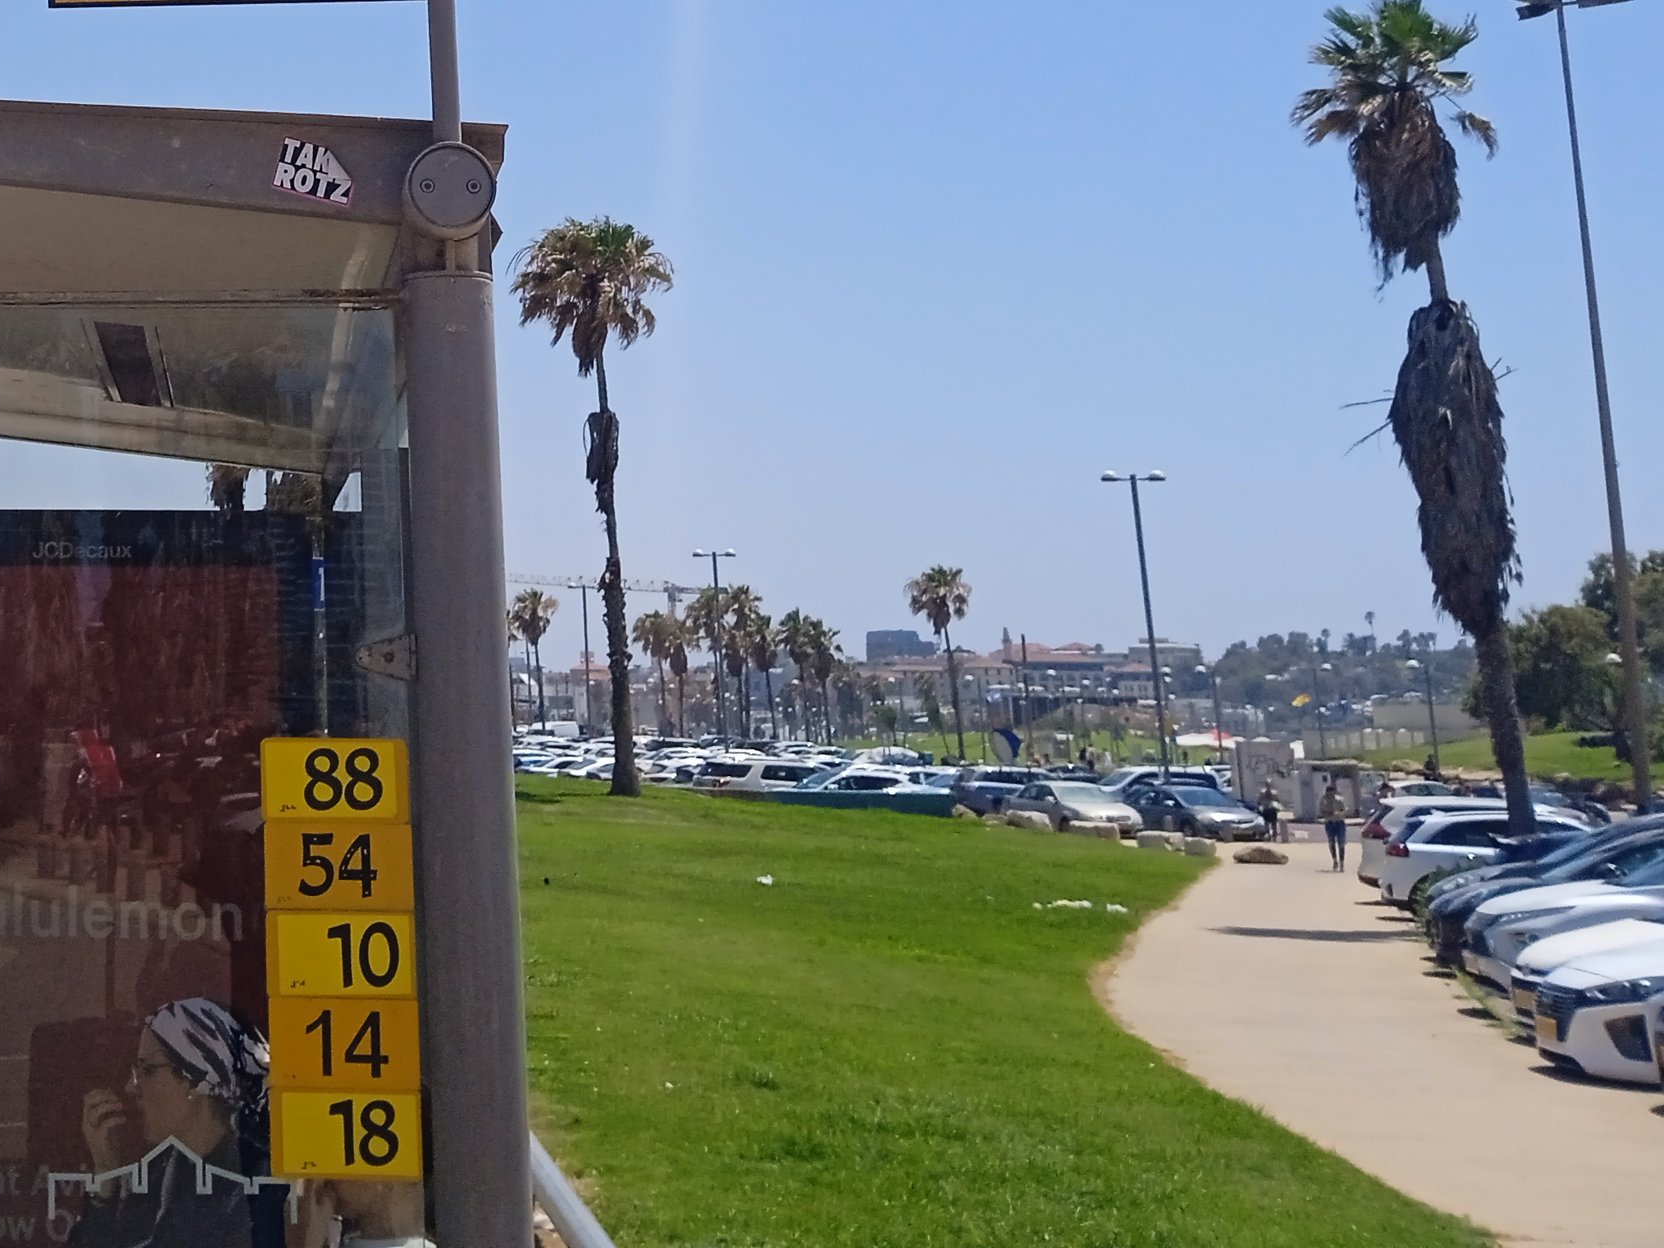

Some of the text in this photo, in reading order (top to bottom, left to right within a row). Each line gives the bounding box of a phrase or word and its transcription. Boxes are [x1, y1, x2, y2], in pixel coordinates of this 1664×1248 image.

[273, 162, 352, 204] ROTZ
[32, 540, 132, 559] JCDecaux
[303, 747, 383, 811] 88
[298, 832, 378, 898] 54
[327, 921, 400, 989] 10
[305, 1009, 390, 1079] 14
[329, 1098, 399, 1167] 18
